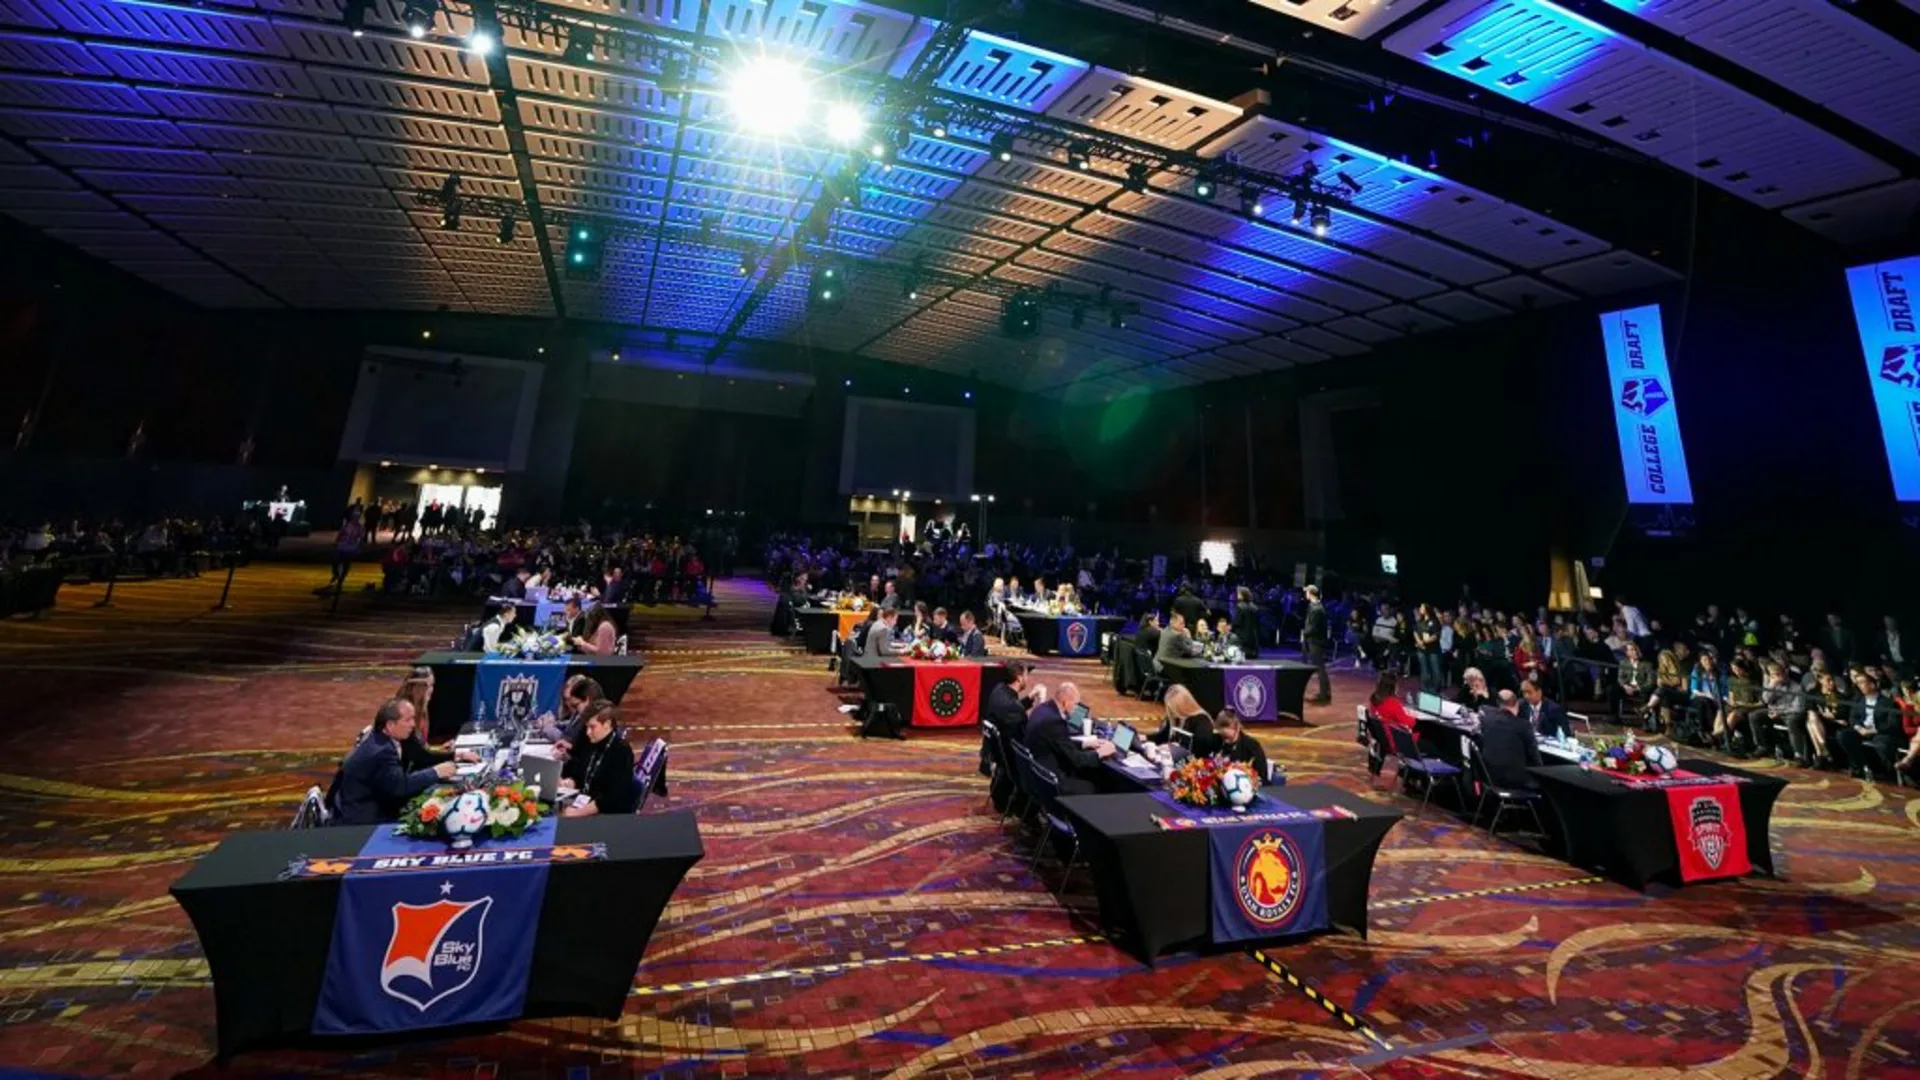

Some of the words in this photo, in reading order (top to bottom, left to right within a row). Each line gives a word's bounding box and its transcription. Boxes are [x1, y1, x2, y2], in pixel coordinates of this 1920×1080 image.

[1881, 271, 1915, 333] DRAFT
[1624, 320, 1645, 370] DRAFT
[1642, 424, 1666, 494] COLLEGE
[373, 857, 425, 869] SKY
[431, 852, 498, 865] BLUE
[503, 850, 533, 861] FC
[434, 953, 473, 966] Blue
[442, 940, 476, 955] Sky
